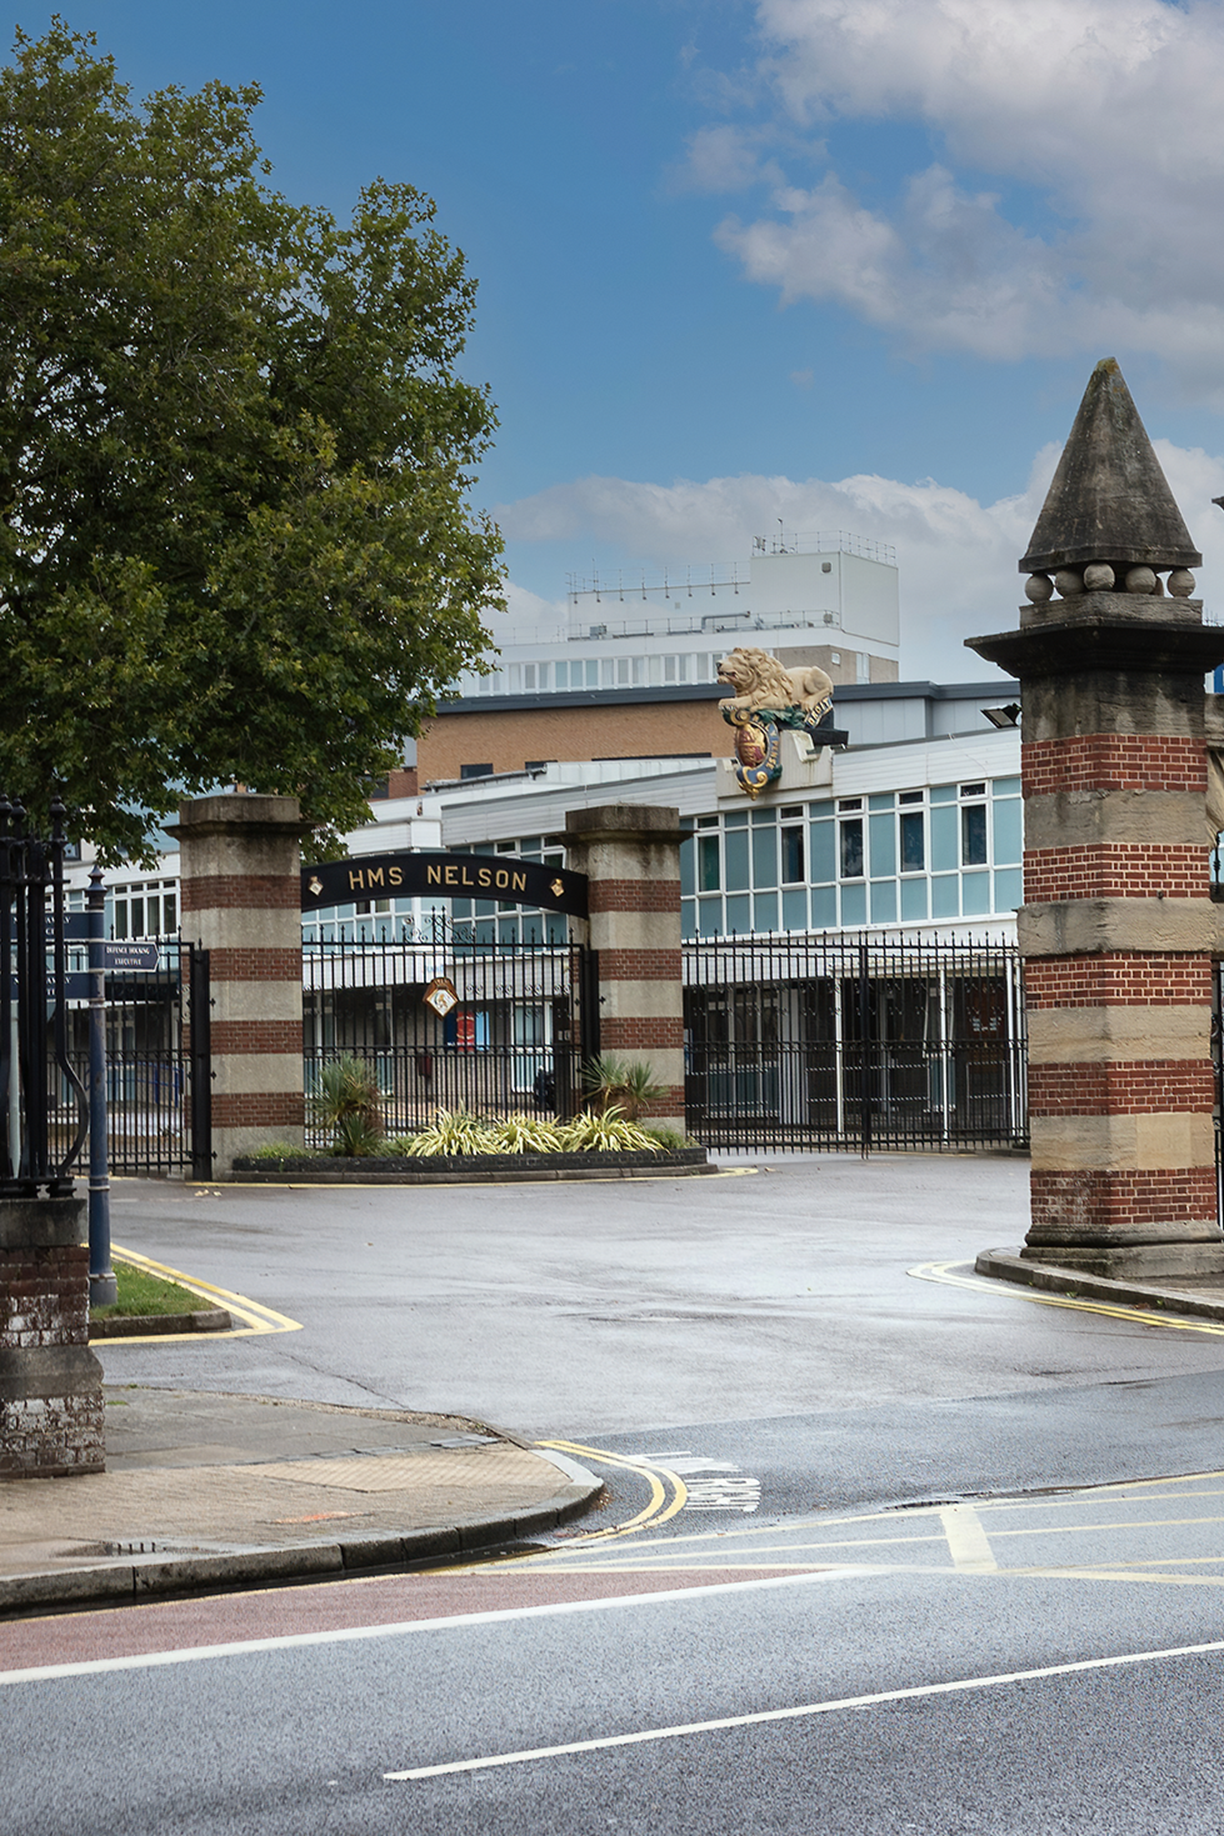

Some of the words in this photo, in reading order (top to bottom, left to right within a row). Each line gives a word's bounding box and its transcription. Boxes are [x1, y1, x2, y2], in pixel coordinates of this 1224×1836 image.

[348, 866, 403, 890] HMS
[427, 864, 527, 891] NELSON
[684, 1477, 762, 1512] RIGHT
